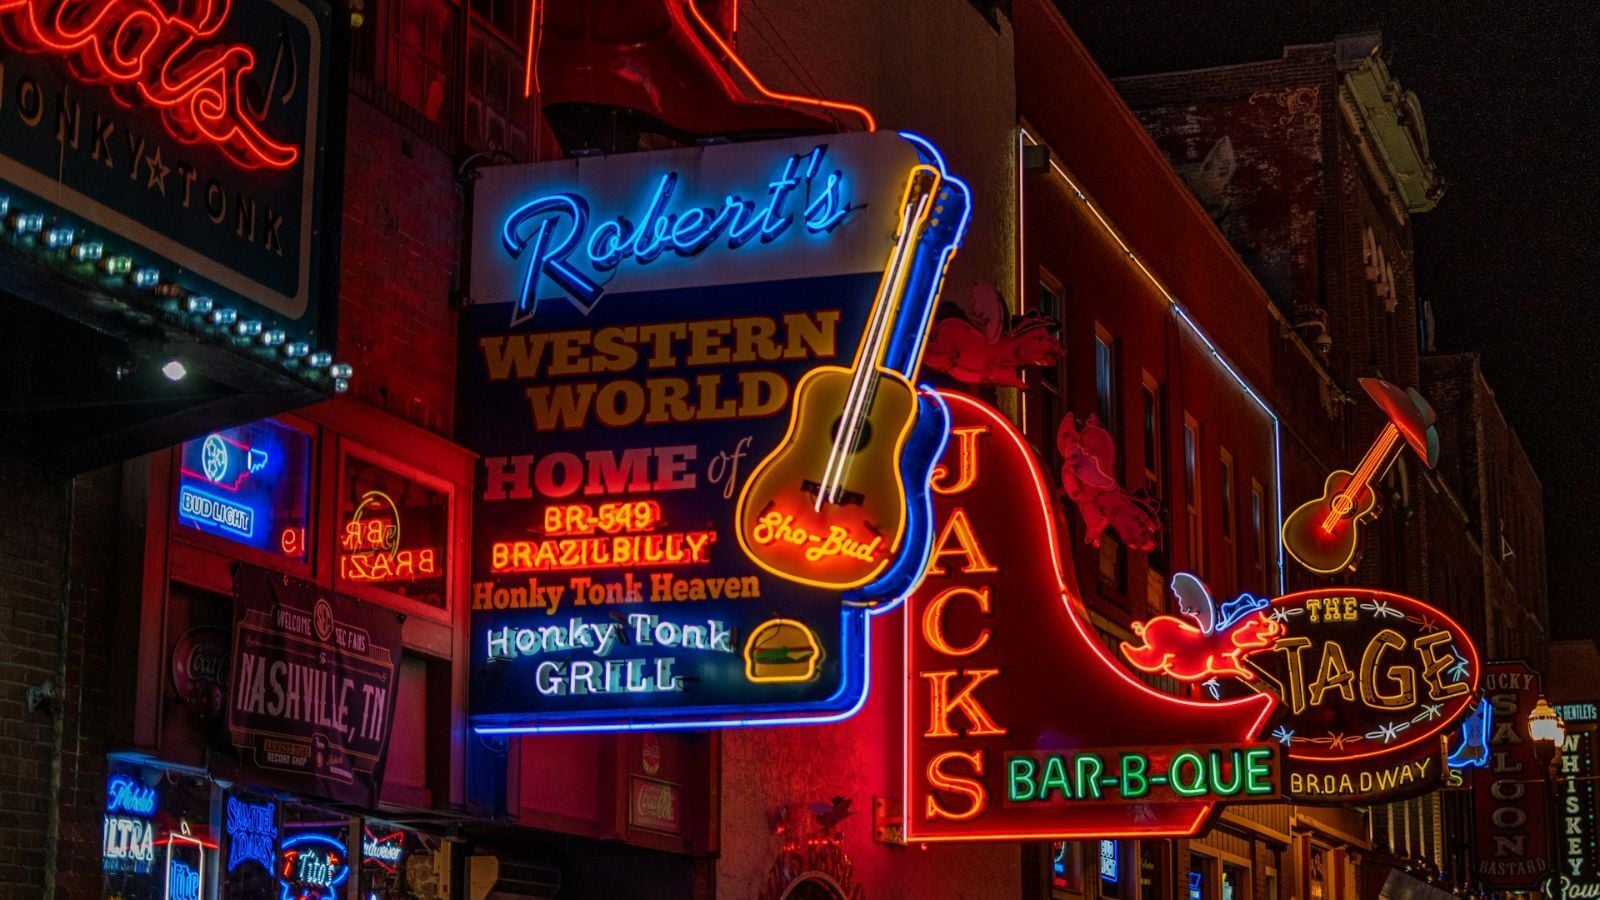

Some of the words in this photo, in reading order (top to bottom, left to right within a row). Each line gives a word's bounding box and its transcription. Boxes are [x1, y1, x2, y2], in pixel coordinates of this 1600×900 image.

[0, 64, 147, 182] ONKY
[177, 164, 284, 257] TONK
[502, 144, 853, 327] Robert's
[481, 310, 841, 380] WESTERN
[526, 371, 790, 434] WORLD
[483, 445, 698, 501] HOME
[707, 436, 753, 499] of
[183, 492, 213, 518] BUD
[212, 499, 250, 531] LIGHT
[543, 500, 662, 537] BR-549
[490, 532, 717, 573] BRAZILBILLY
[752, 510, 884, 563] Sho-Bud
[472, 577, 565, 616] Honky
[570, 573, 644, 607] Tonk
[650, 572, 761, 602] Heaven
[1306, 596, 1359, 623] THE
[276, 609, 313, 638] WELCOME
[335, 628, 347, 648] SEC
[348, 632, 366, 652] FANS
[486, 616, 620, 662] Honky
[627, 613, 735, 653] Tonk
[920, 425, 1008, 821] JACKS
[535, 657, 684, 696] GRILL
[1486, 672, 1535, 691] UCKY
[360, 682, 387, 742] TN
[1007, 746, 1273, 801] BAR-B-QUE
[1290, 757, 1431, 795] BROADWAY
[1490, 693, 1527, 857] SALOON
[226, 796, 279, 839] SAMUEL
[228, 830, 277, 873] ADAMS
[299, 849, 334, 887] Tito's
[1479, 857, 1547, 876] BASTARD
